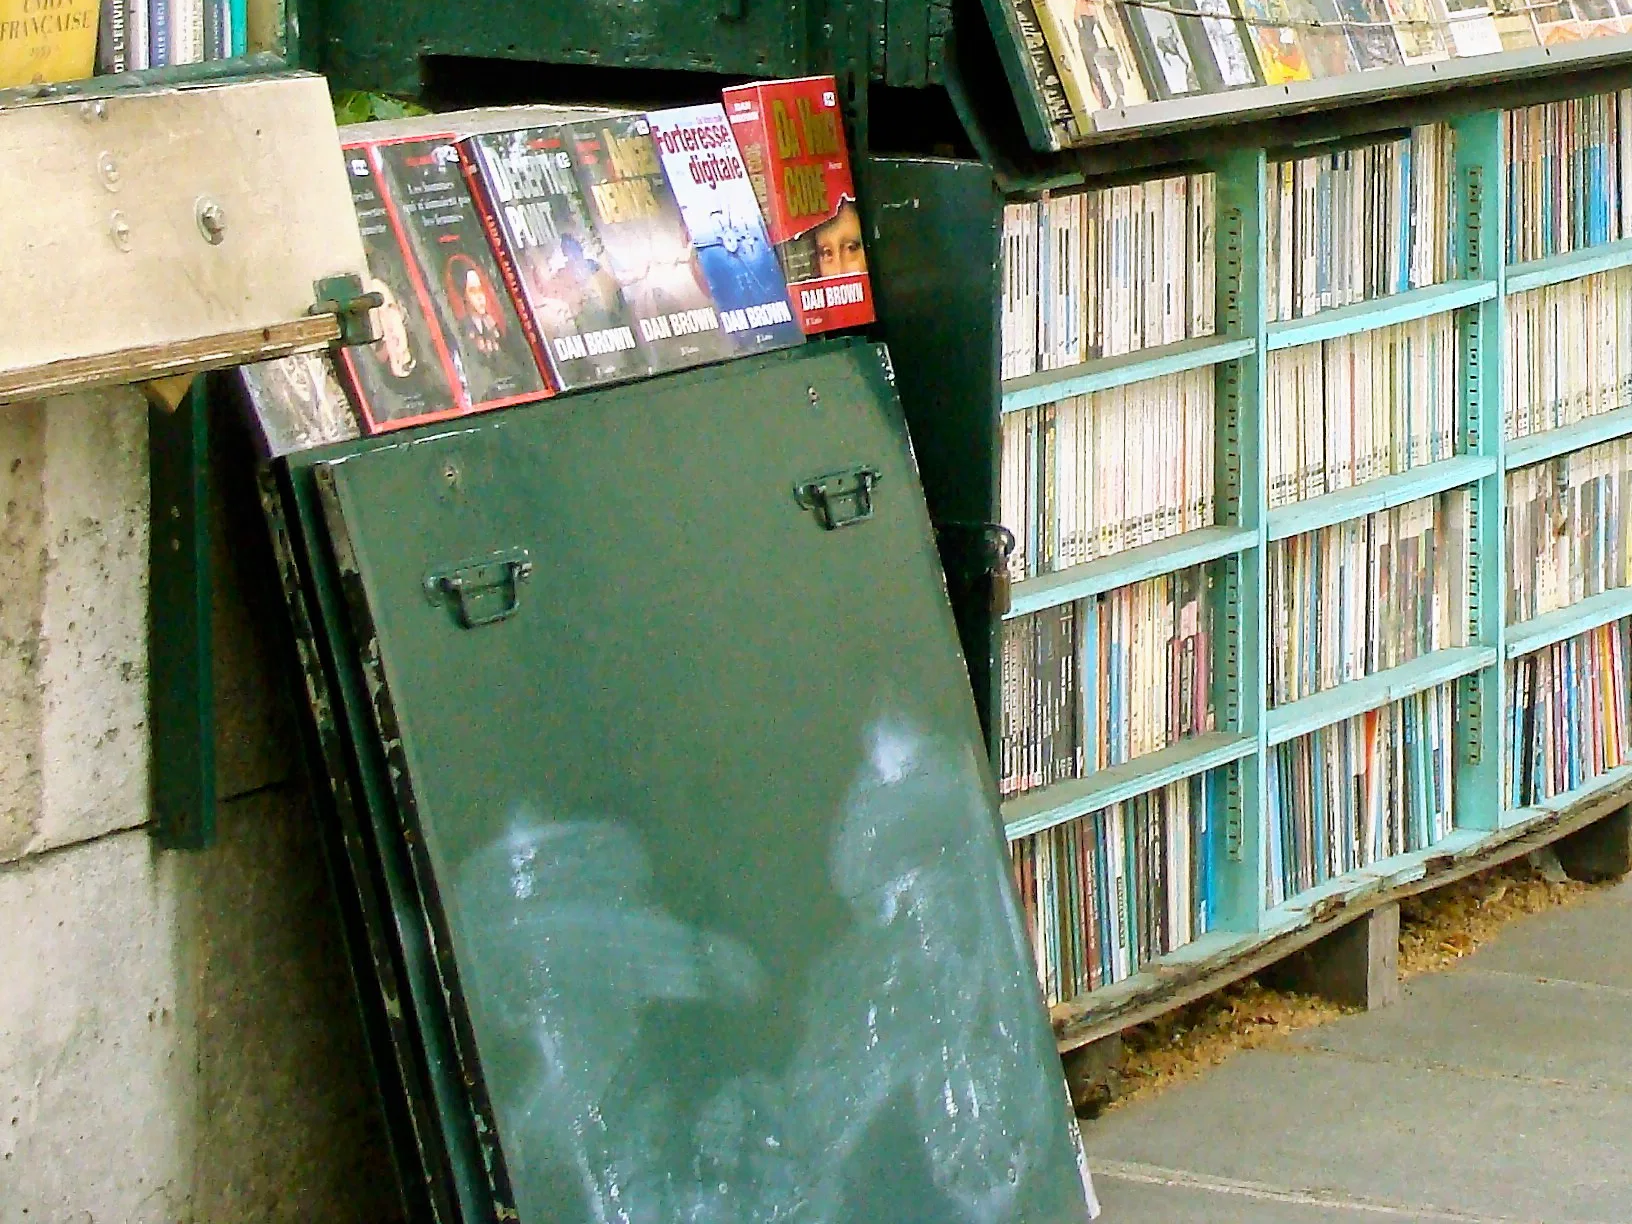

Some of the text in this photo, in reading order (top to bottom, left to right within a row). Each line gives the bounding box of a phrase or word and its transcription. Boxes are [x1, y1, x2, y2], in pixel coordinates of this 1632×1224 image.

[0, 9, 93, 41] FRANÇAISE
[113, 55, 125, 74] DE
[651, 123, 731, 156] Forteresse
[689, 153, 744, 190] digitale
[801, 282, 864, 312] DAN BROWN
[639, 307, 719, 342] DAN BROWN
[720, 300, 793, 334] DAN BROWN
[553, 326, 636, 363] DAN BROWN
